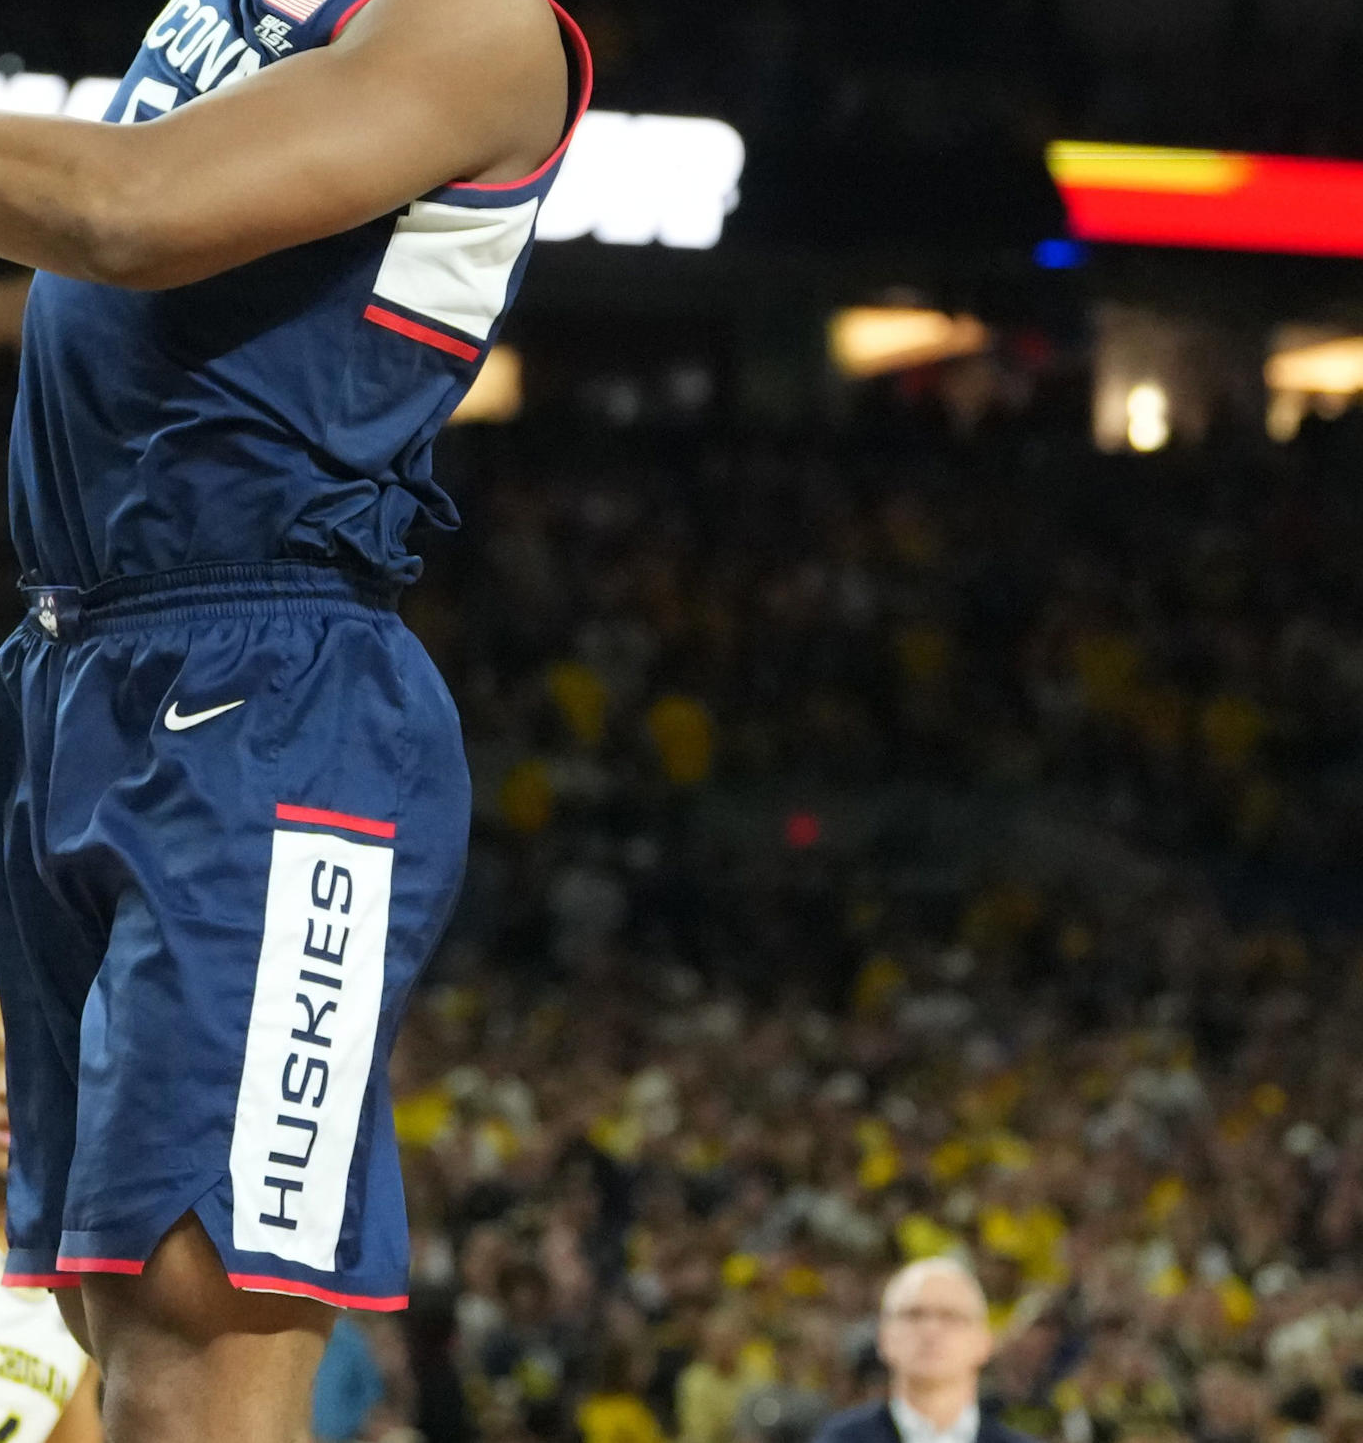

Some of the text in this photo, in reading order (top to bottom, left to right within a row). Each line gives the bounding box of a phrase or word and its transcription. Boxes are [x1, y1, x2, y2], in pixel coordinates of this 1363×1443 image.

[254, 24, 294, 52] EAST
[260, 14, 293, 37] BIG
[258, 859, 353, 1231] HUSKIES
